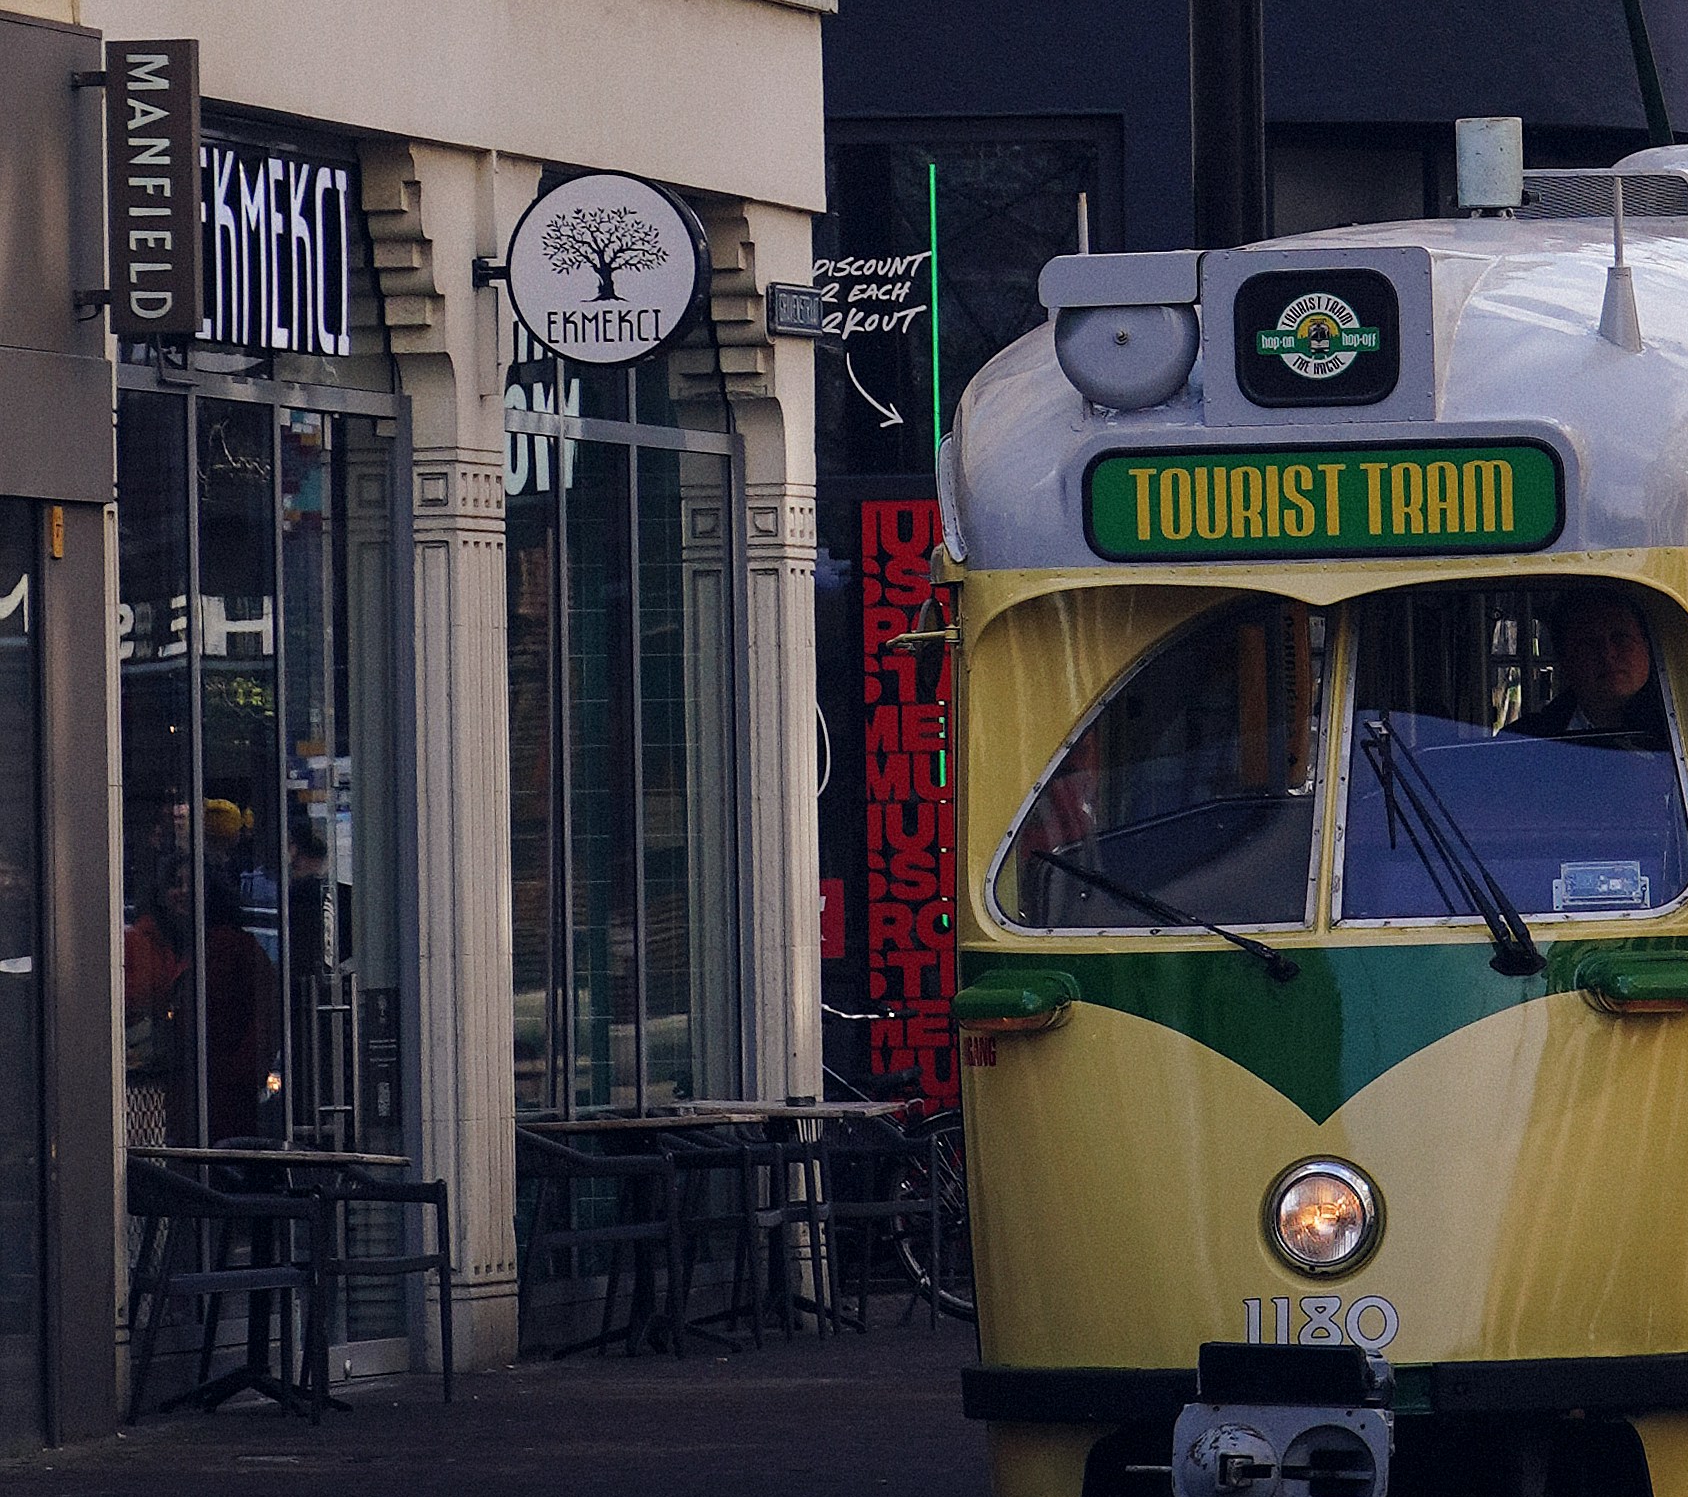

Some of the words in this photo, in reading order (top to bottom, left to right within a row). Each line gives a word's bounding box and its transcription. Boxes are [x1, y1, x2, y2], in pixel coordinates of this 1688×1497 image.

[125, 54, 173, 320] MANFIELD
[812, 250, 933, 278] DISCOUNT
[847, 281, 912, 303] EACH
[547, 308, 662, 344] EKMEKCI
[1281, 295, 1322, 329] TOURIST
[1325, 297, 1354, 326] TRAM
[1292, 355, 1310, 375] THE
[1128, 462, 1347, 541] TOURIST
[1359, 458, 1515, 536] TRAM
[1242, 1294, 1400, 1350] 1180
